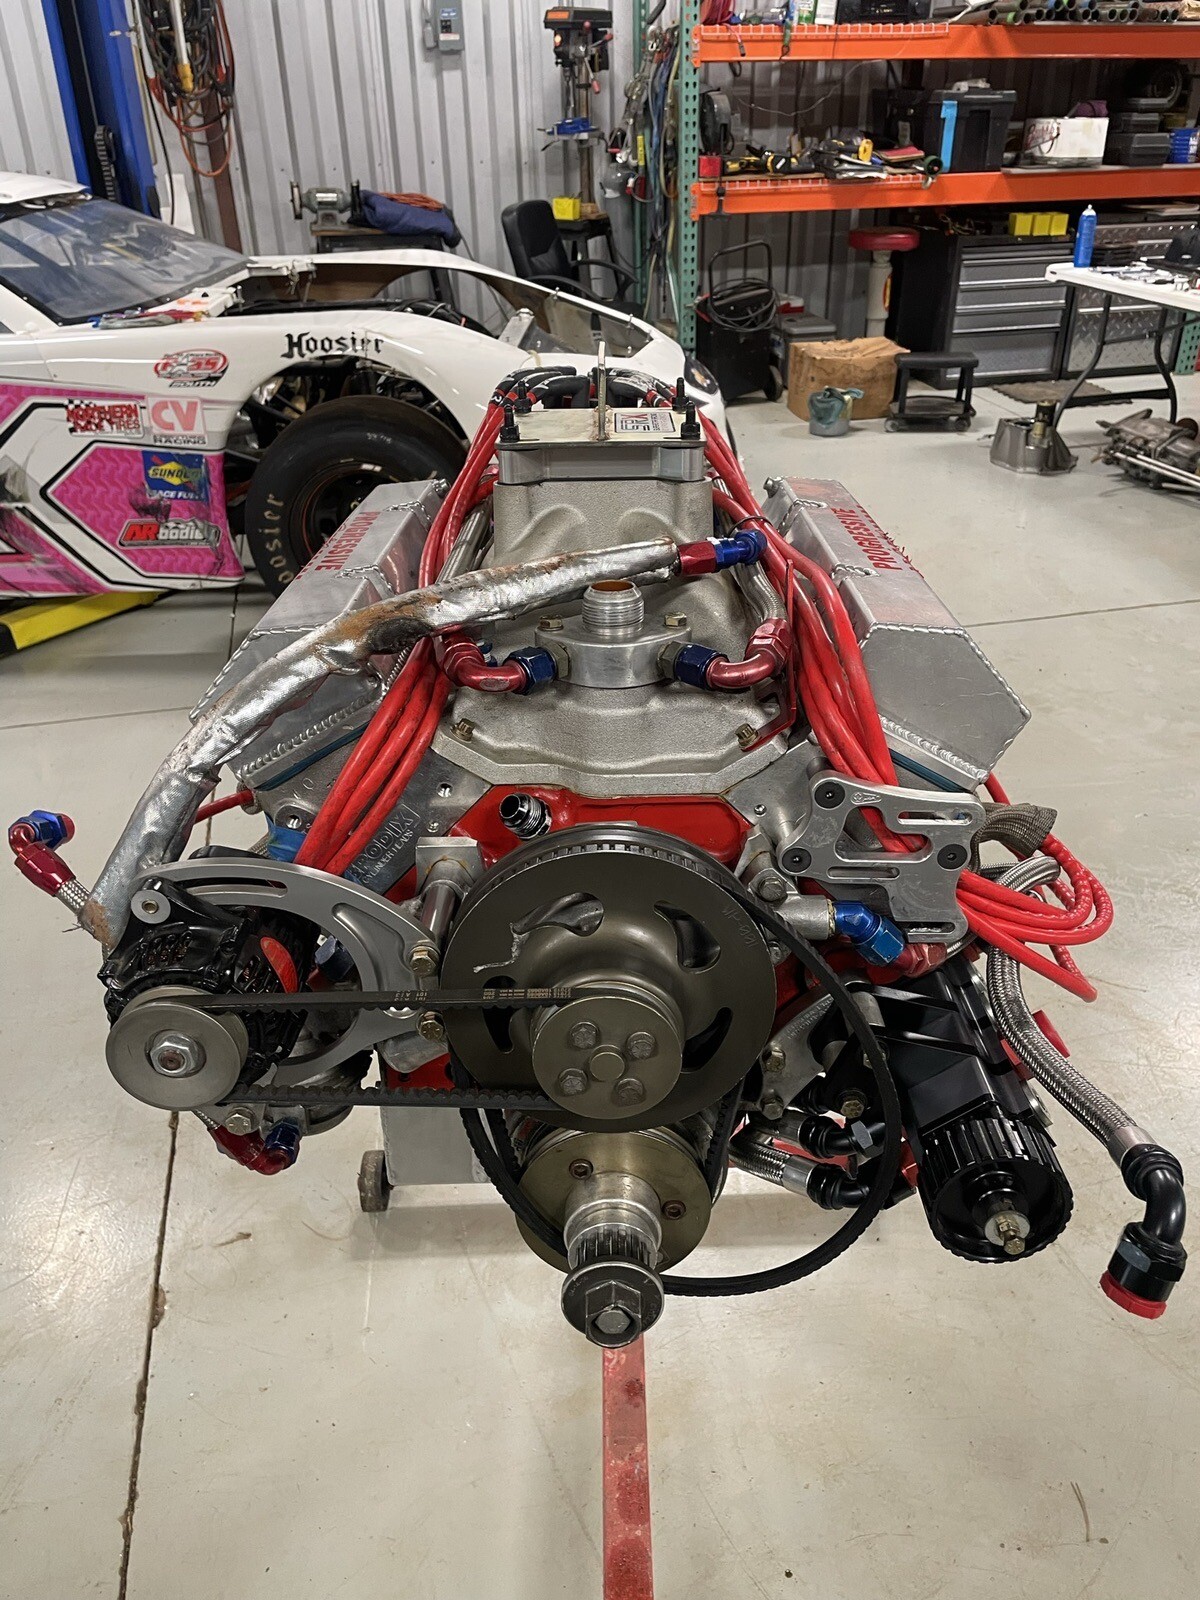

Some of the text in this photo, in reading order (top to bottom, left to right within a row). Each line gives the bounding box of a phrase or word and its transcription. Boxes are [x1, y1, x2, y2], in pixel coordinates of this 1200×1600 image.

[281, 331, 384, 358] Hoosier
[152, 401, 198, 431] CV
[153, 436, 207, 445] RACING
[263, 493, 295, 584] oosier
[314, 511, 380, 571] PROGRESSIVE
[830, 507, 902, 570] PROGRESSIVE
